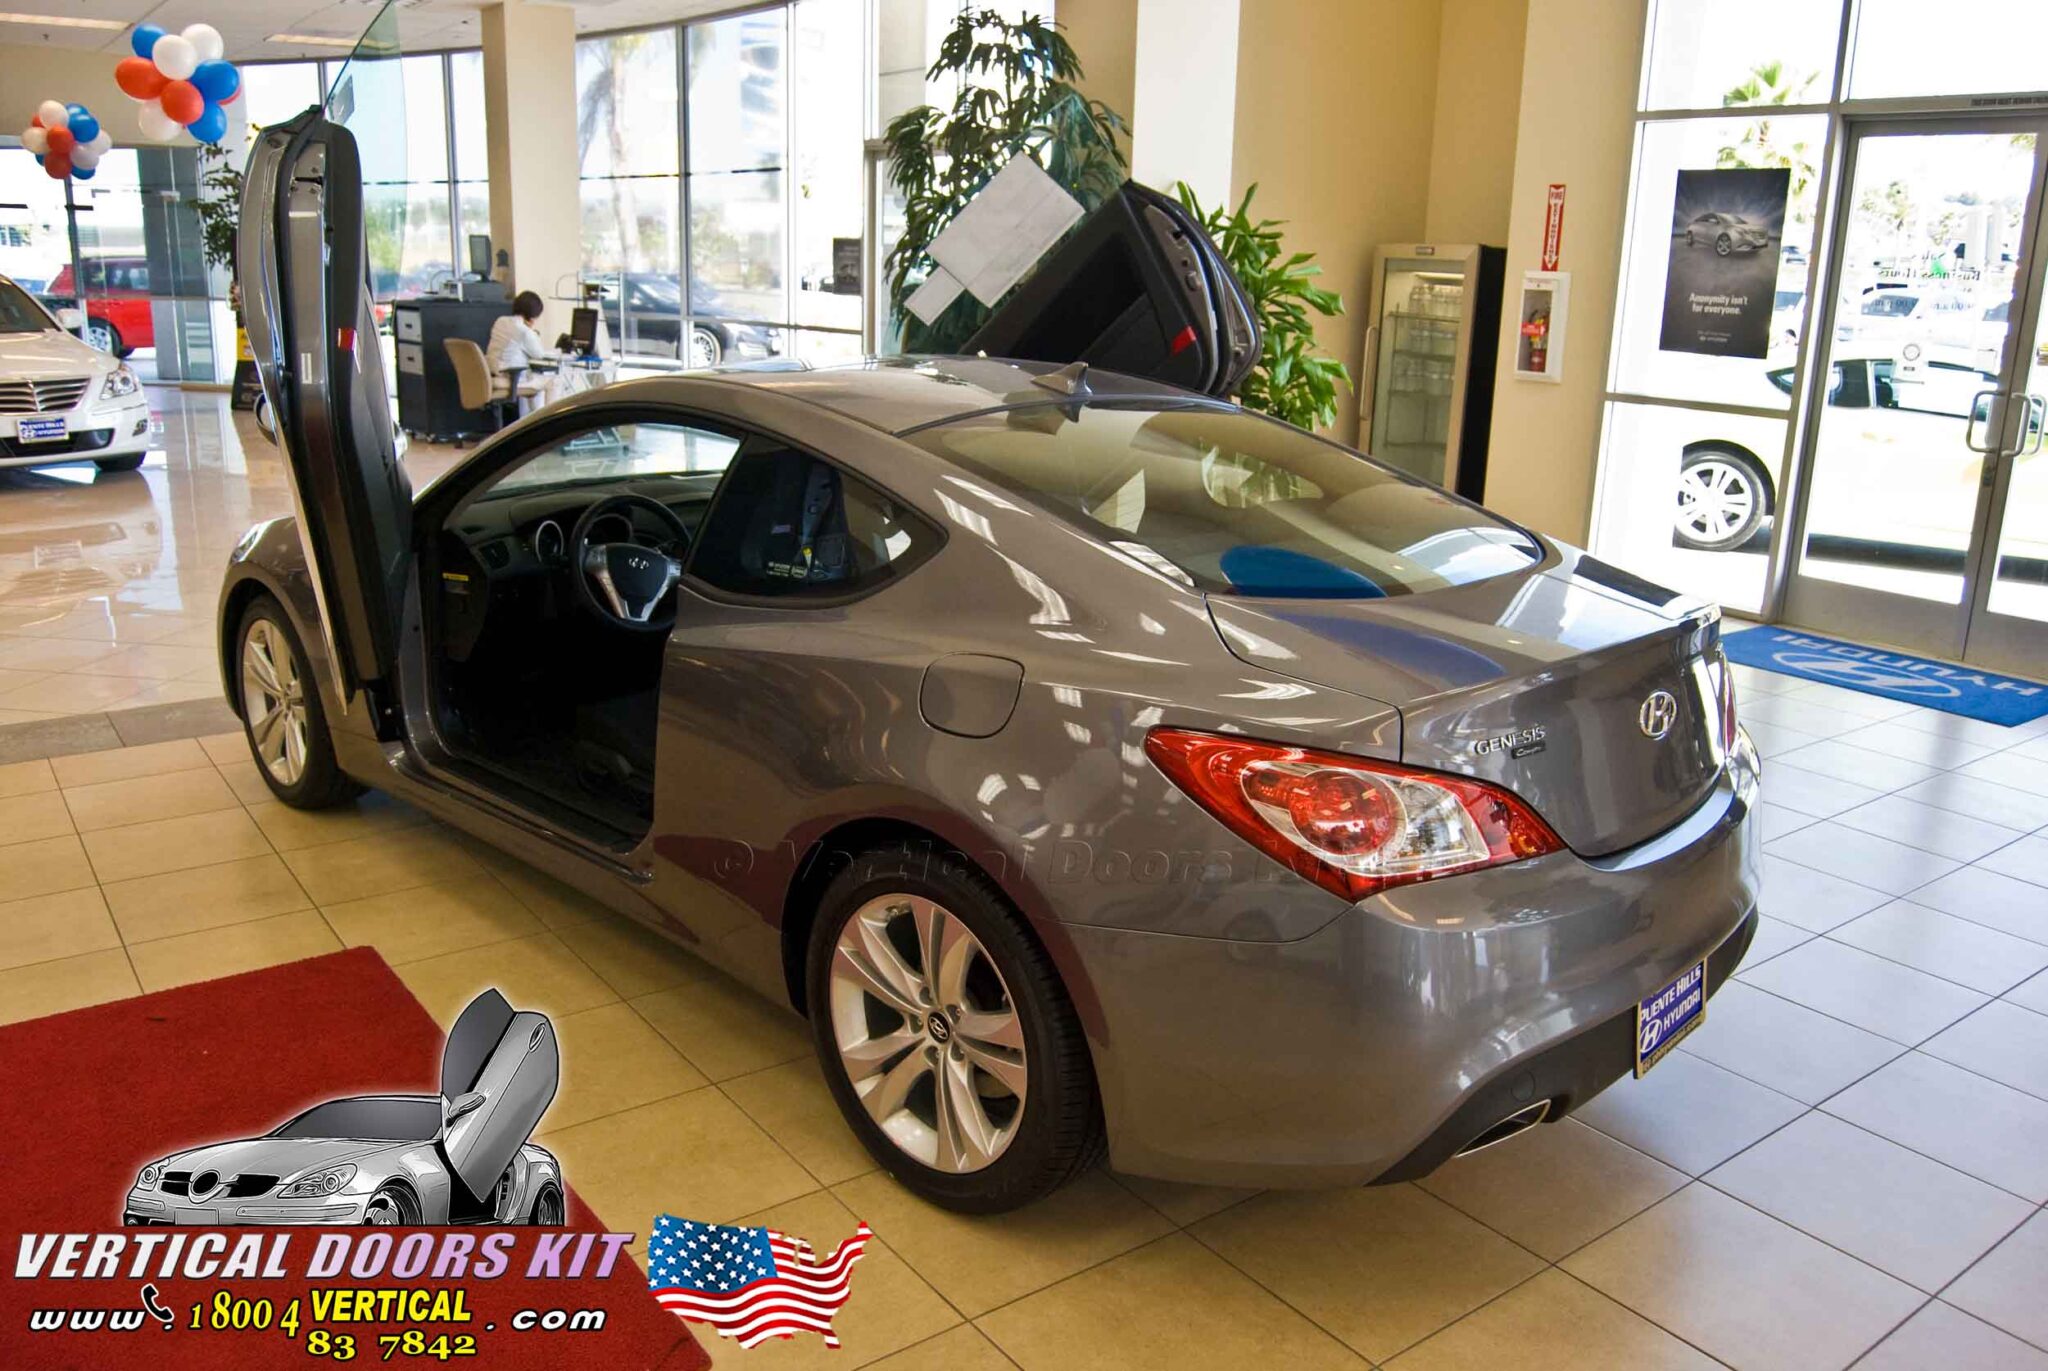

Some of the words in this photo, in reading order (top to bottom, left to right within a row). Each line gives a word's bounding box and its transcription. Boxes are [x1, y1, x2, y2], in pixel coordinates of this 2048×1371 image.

[1689, 292, 1731, 306] Anonymity
[1731, 295, 1748, 305] isn't
[1692, 303, 1703, 312] for
[1704, 305, 1742, 315] everyone.
[1772, 634, 2043, 696] HYUNDAI
[1475, 726, 1546, 755] GENESIS
[1640, 987, 1676, 1023] PUENTE
[1676, 965, 1701, 998] HILLS
[1664, 987, 1701, 1031] HYUNDAI
